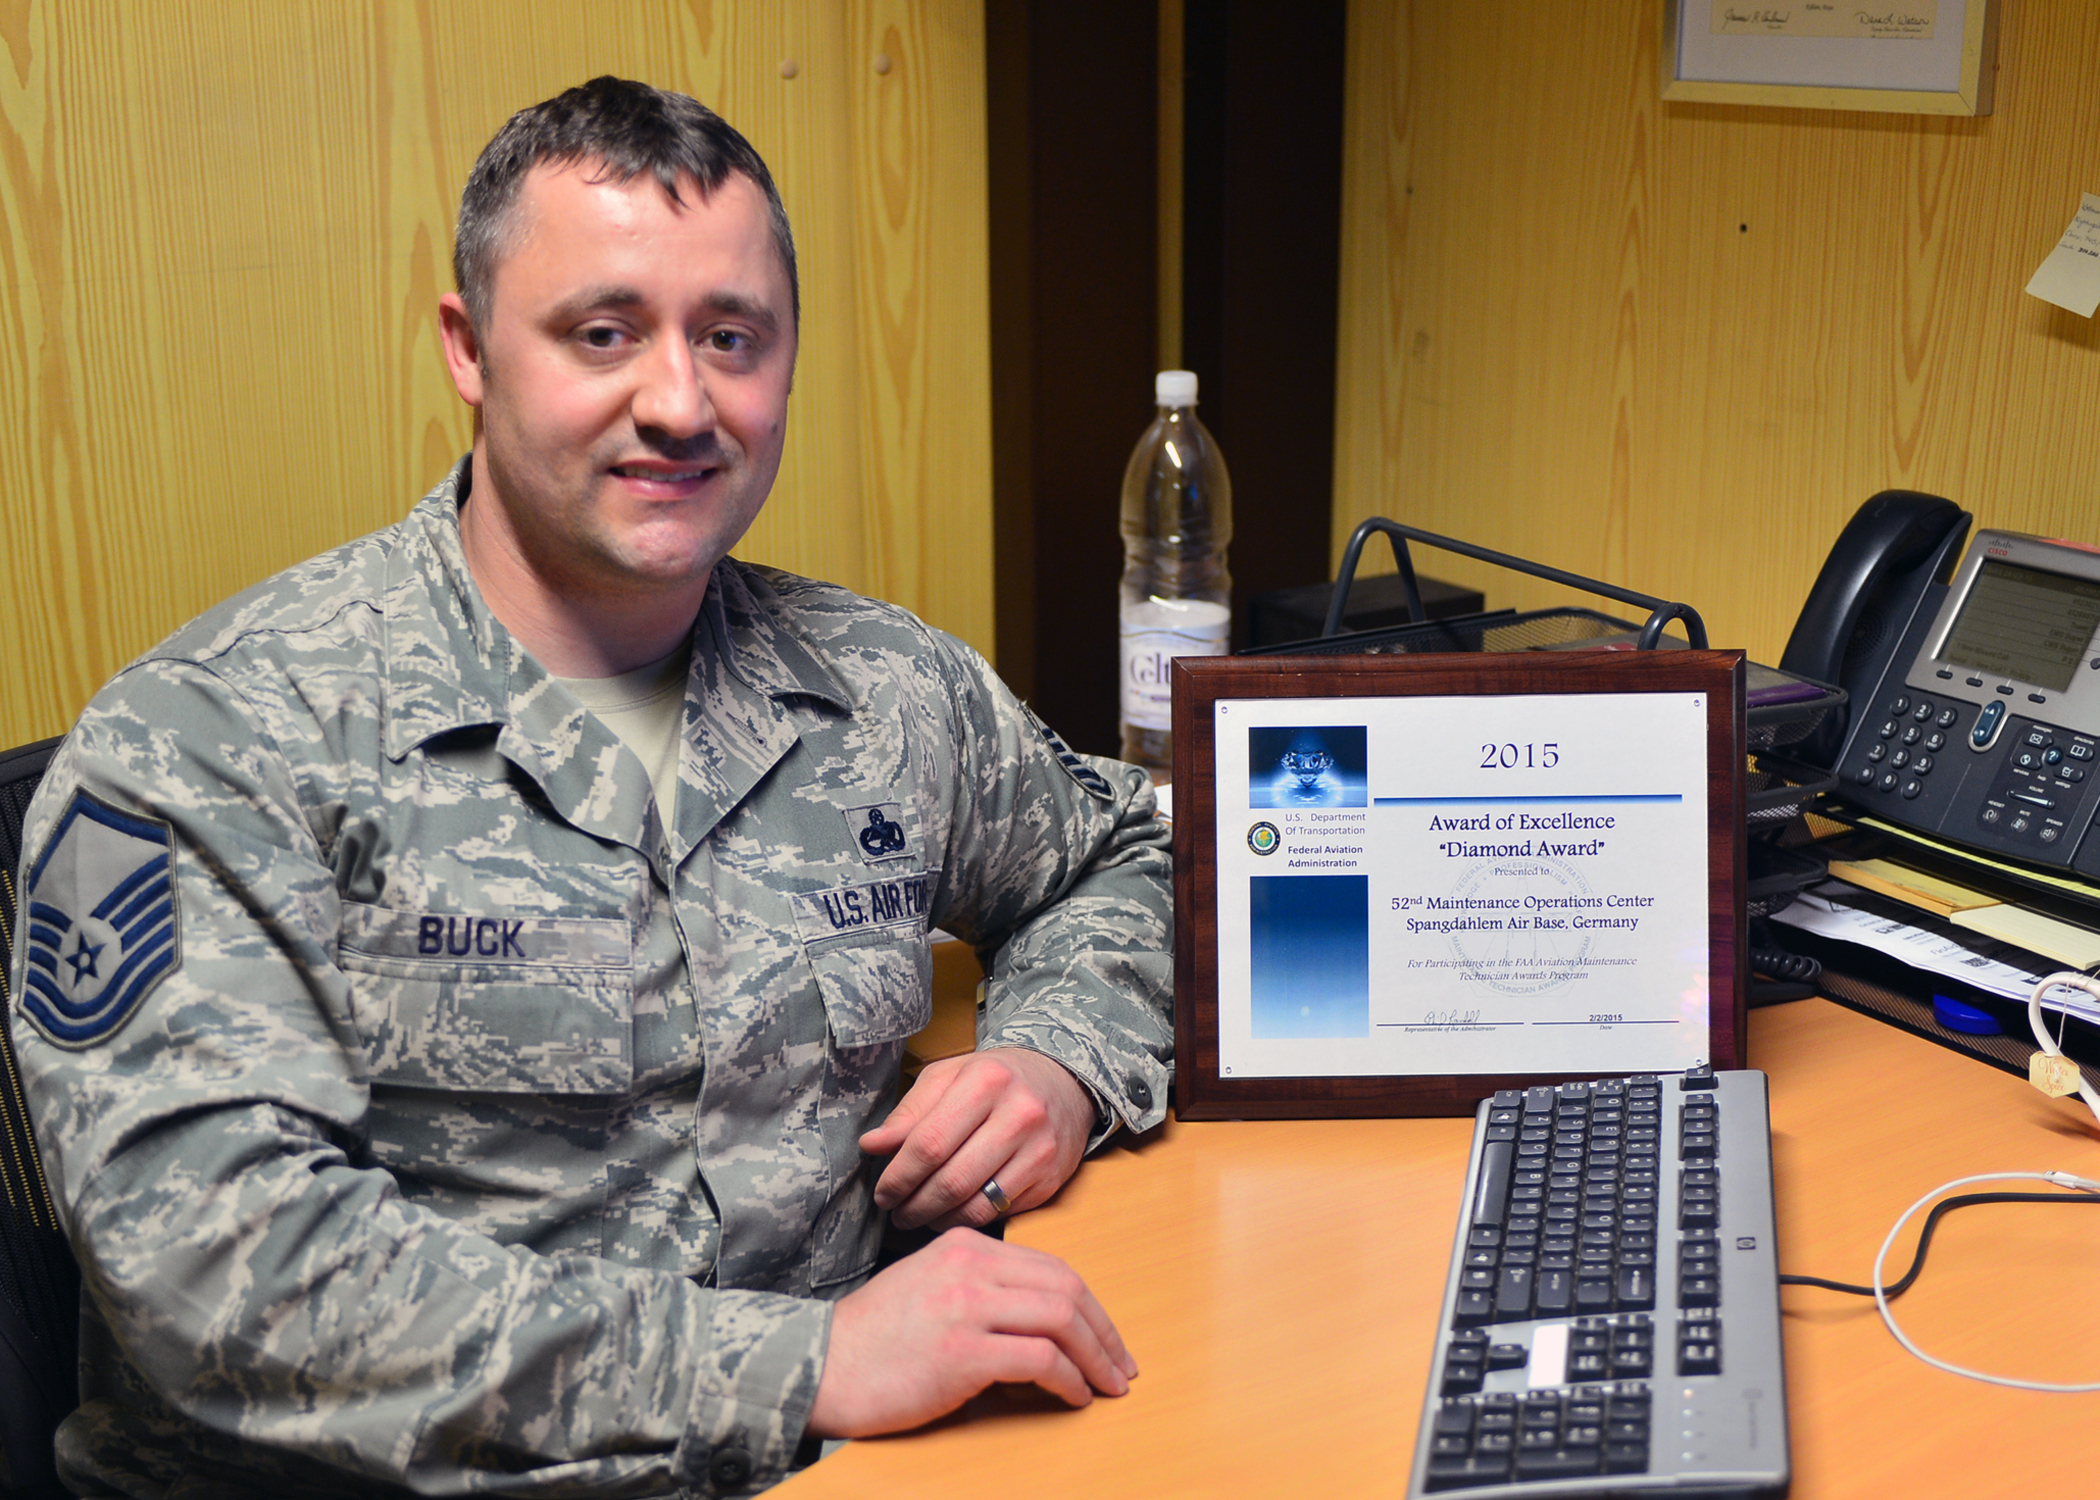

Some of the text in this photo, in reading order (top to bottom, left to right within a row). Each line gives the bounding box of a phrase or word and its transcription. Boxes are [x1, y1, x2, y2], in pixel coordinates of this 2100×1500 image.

[1480, 743, 1559, 768] 2015
[1285, 812, 1366, 823] U.S. Department
[1429, 812, 1616, 831] Award of Excellence
[1285, 826, 1366, 837] Of Transportation
[1287, 845, 1363, 855] Federal Aviation
[1287, 858, 1358, 868] Administration
[1494, 866, 1550, 877] Presented to
[823, 890, 869, 930] U.S.
[870, 883, 904, 922] AIR
[1391, 895, 1423, 910] 52nd
[1426, 896, 1520, 910] Maintenance
[1523, 894, 1603, 912] Operations
[1606, 894, 1655, 908] Center
[1406, 915, 1639, 934] Spangdahlem Air Base, Germany
[418, 916, 526, 958] BUCK
[1407, 956, 1638, 970] For Participating in the FAA Aviation Maintenance
[1459, 970, 1589, 981] Technician Awards Program
[1588, 1013, 1623, 1023] 2/2/2015
